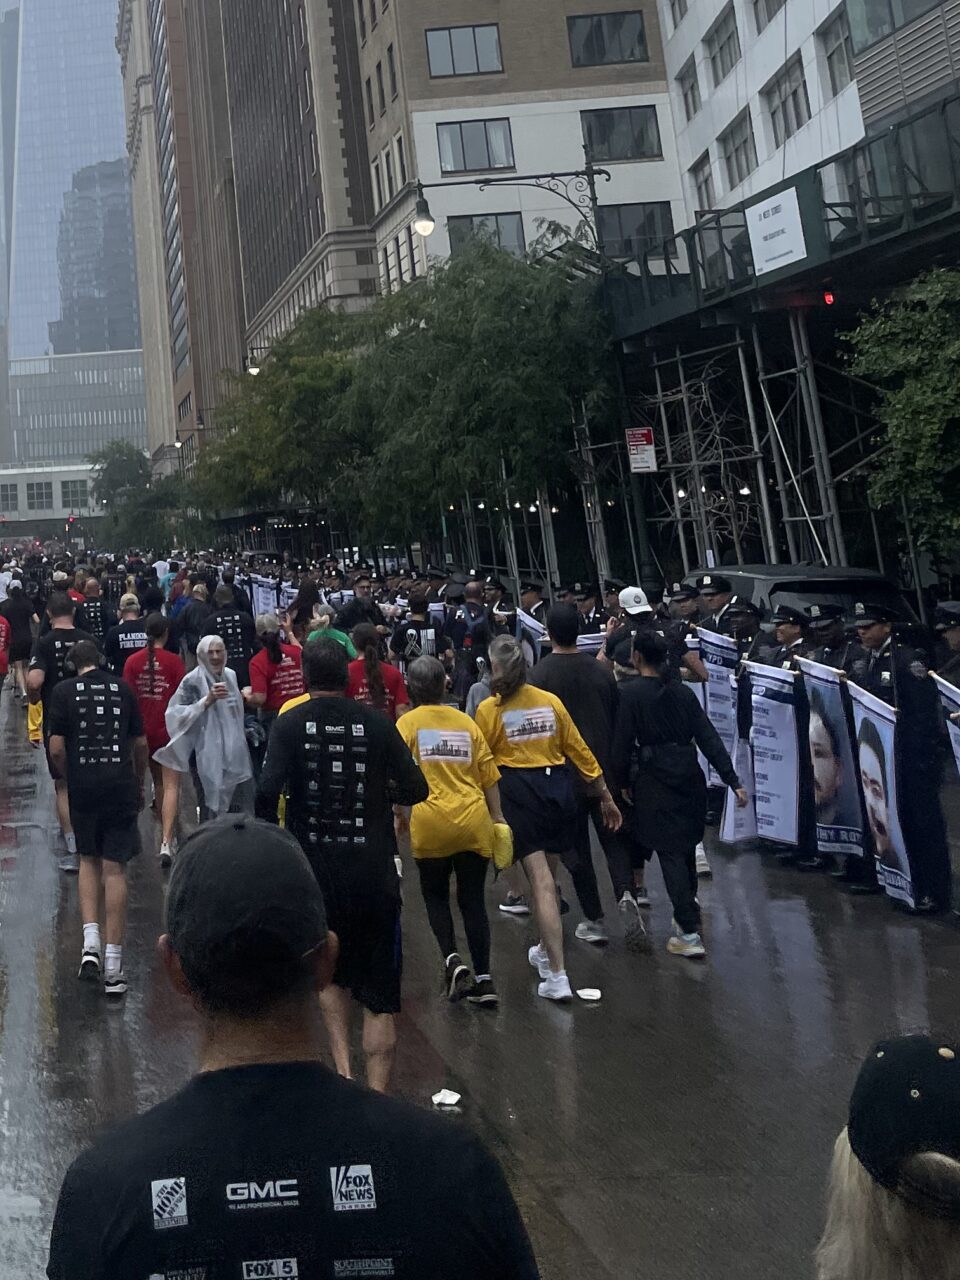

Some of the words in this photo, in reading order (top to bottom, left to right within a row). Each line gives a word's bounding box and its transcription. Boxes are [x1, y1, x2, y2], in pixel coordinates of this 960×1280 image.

[706, 653, 723, 666] YPD
[345, 1174, 372, 1188] FOX
[226, 1179, 298, 1200] GMC
[340, 1188, 374, 1202] NEWS
[245, 1262, 275, 1277] FOX
[282, 1261, 293, 1275] 5
